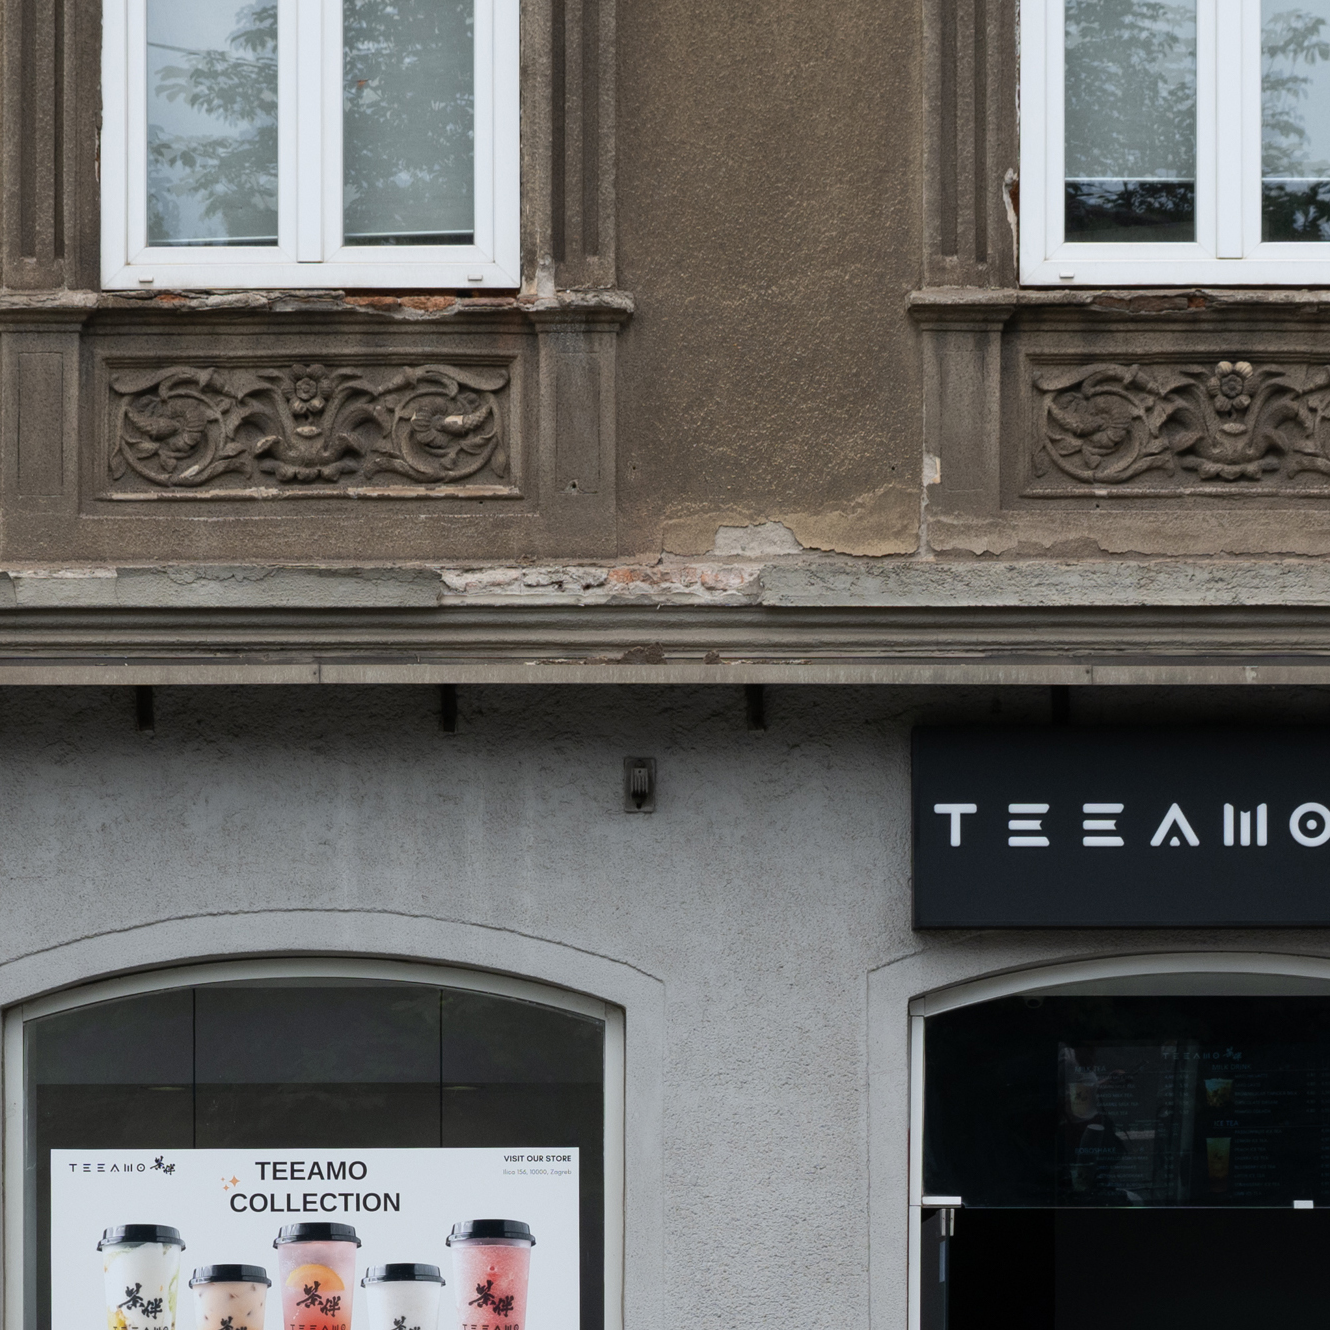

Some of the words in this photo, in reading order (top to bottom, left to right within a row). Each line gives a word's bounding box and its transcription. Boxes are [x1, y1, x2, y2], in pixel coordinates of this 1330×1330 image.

[68, 1163, 146, 1173] TEEAMO
[255, 1160, 368, 1181] TEEAMO
[550, 1168, 572, 1176] Zagreb
[229, 1192, 401, 1213] COLLECTION
